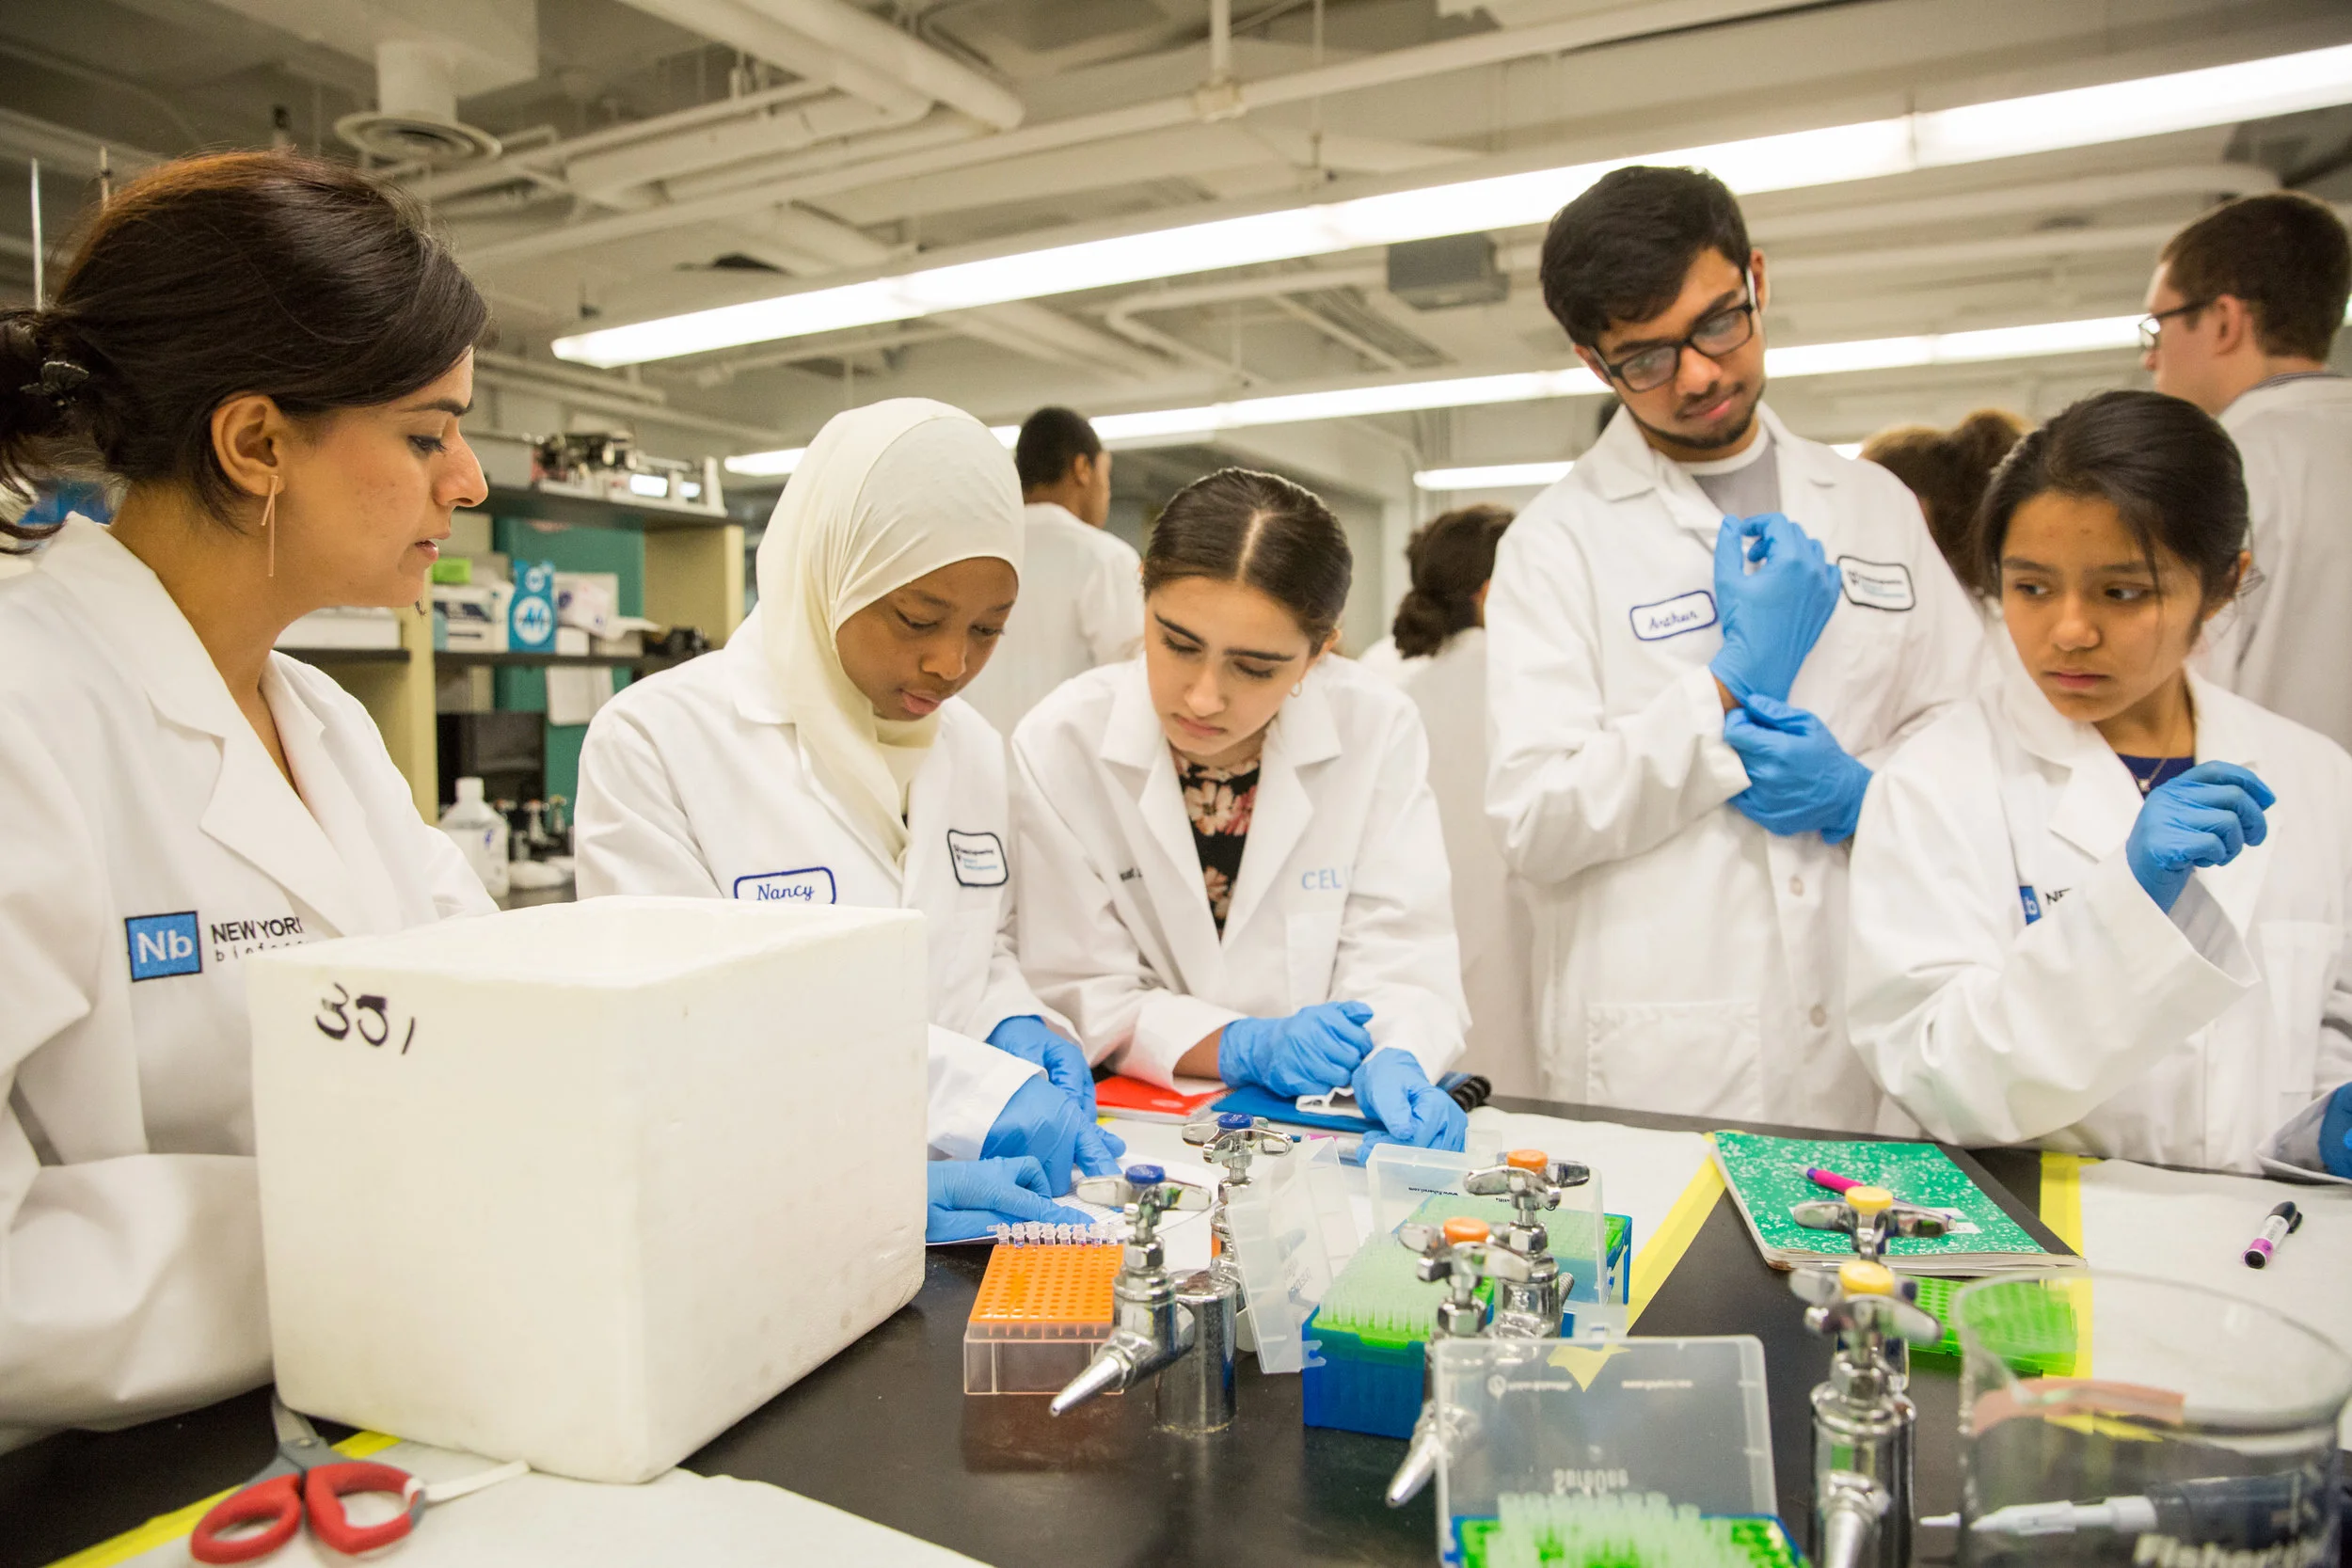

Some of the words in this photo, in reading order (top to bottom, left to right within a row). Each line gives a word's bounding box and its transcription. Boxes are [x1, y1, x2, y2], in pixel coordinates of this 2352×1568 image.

[1302, 866, 1345, 891] CEL
[756, 883, 816, 901] Nancy
[211, 920, 257, 944] NEW
[136, 929, 194, 964] Nb
